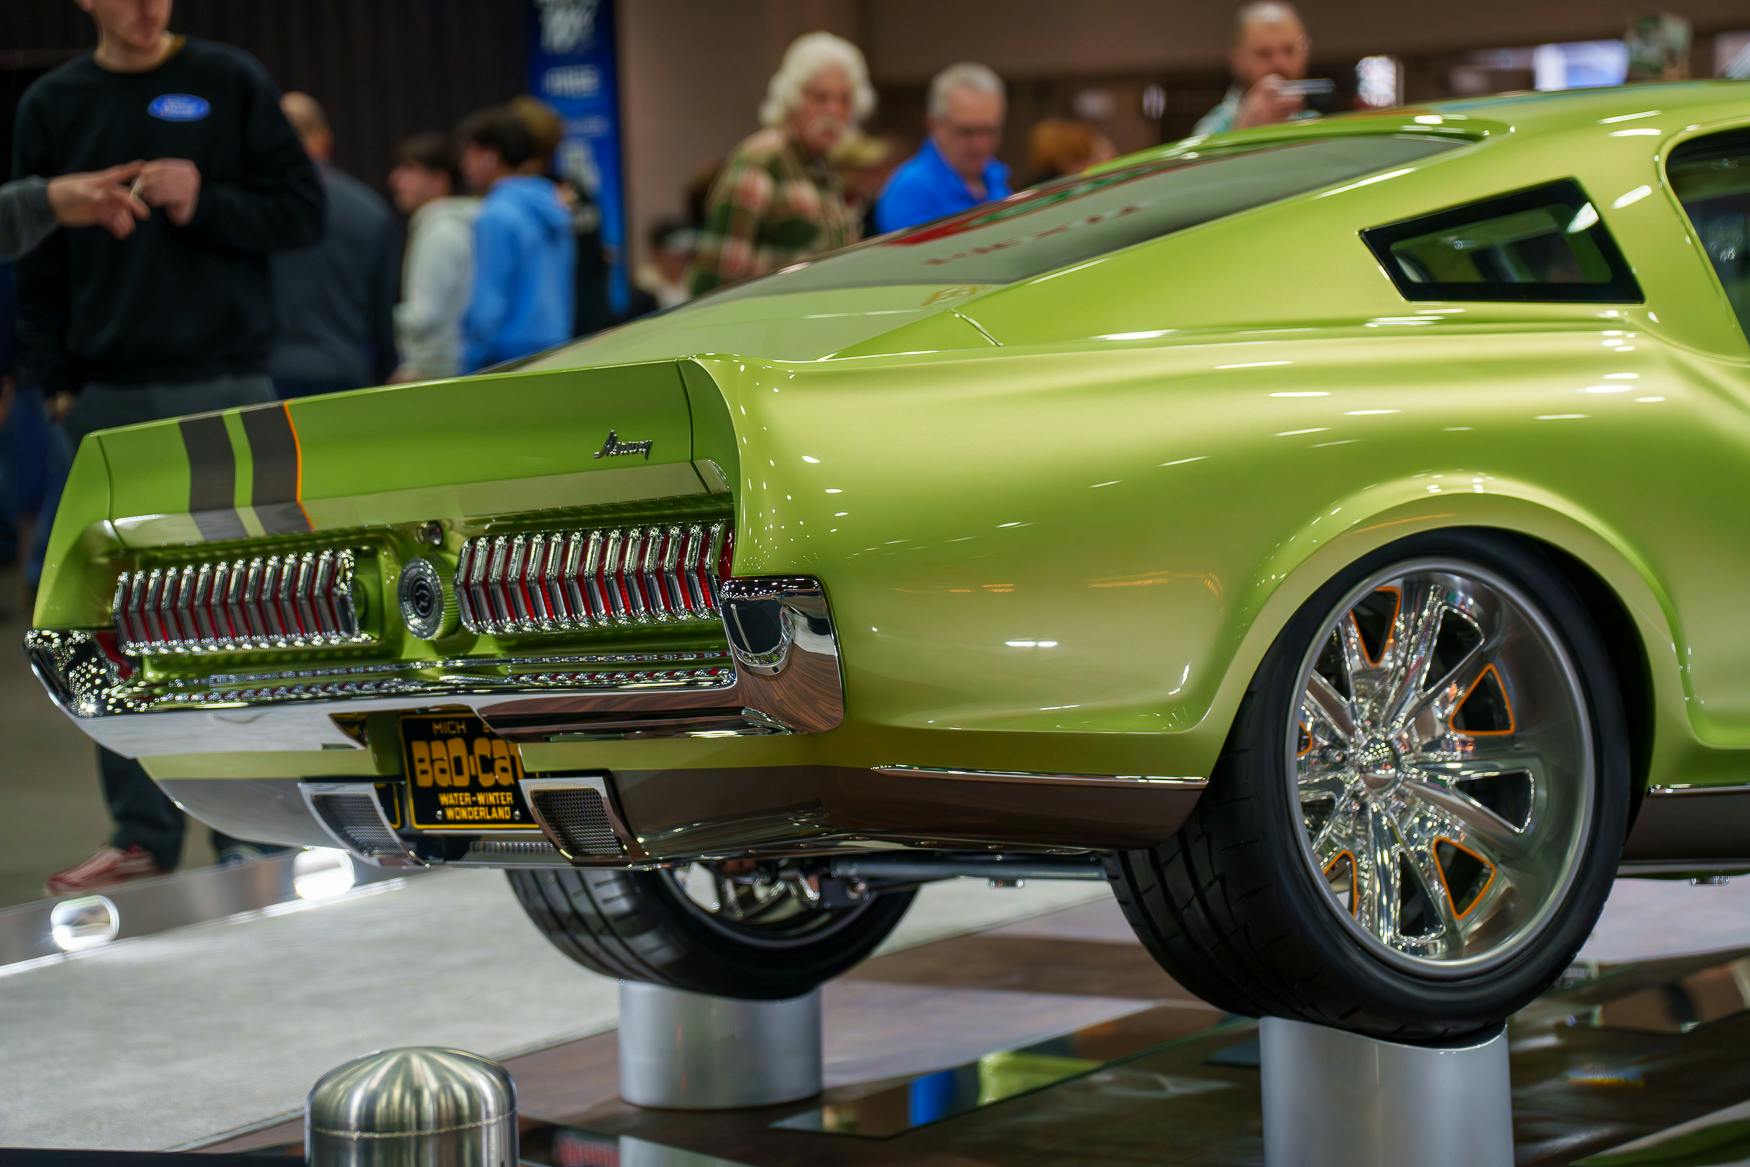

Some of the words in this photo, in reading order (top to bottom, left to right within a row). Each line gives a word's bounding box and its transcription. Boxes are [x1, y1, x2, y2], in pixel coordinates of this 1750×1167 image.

[432, 721, 467, 734] MICH
[438, 791, 514, 806] WATER-WINTER
[445, 806, 512, 820] WONDERLAND
